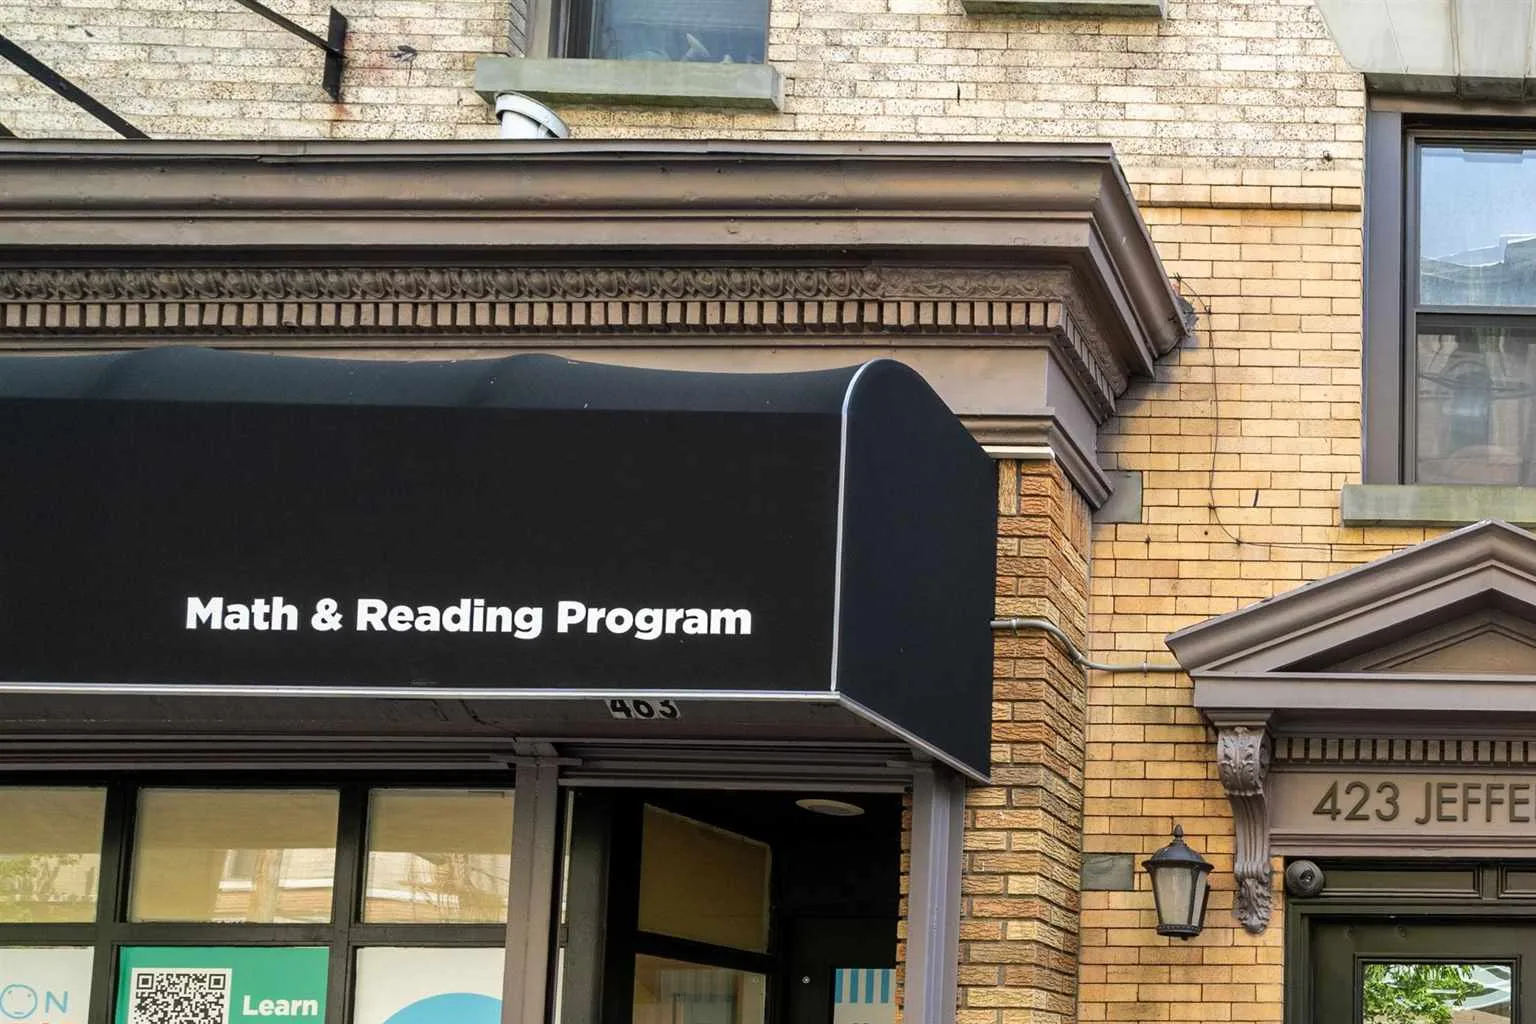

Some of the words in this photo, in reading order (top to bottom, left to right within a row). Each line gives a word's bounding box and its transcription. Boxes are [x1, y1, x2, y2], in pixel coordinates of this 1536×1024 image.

[186, 596, 299, 631] Math
[311, 597, 343, 632] &
[356, 598, 543, 640] Reading
[557, 600, 752, 640] Program
[610, 699, 678, 719] 463
[1312, 779, 1400, 822] 423
[242, 995, 318, 1016] Learn
